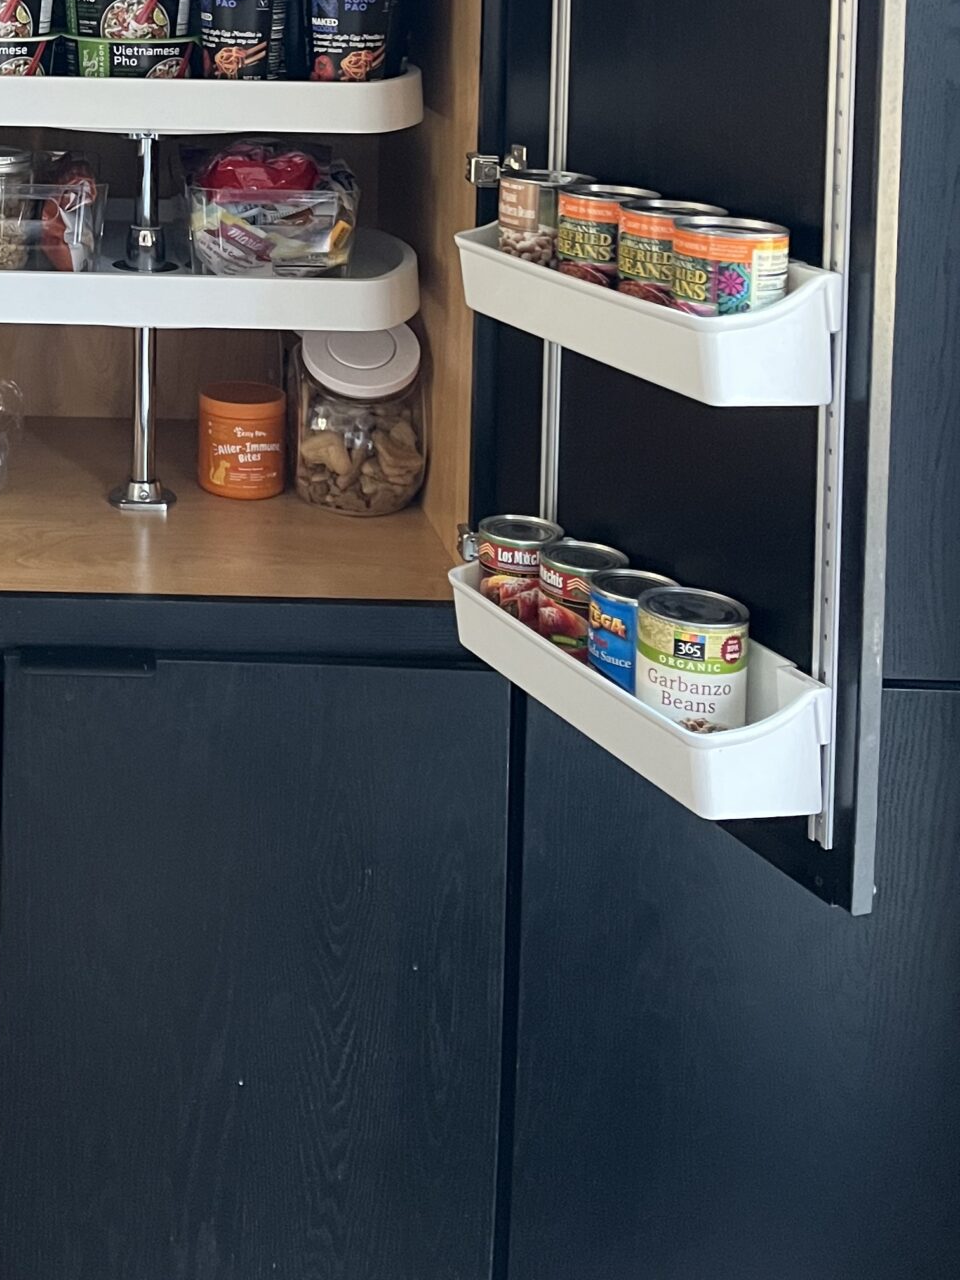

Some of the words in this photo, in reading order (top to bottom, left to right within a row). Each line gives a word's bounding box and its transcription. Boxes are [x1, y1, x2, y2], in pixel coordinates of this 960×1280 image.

[215, 0, 237, 8] PAO
[344, 3, 367, 11] PAO
[312, 17, 338, 26] NAKED
[113, 46, 180, 57] Vietnamese
[114, 56, 138, 67] Pho
[218, 442, 280, 455] Aller-Immune
[238, 453, 261, 463] Bites
[498, 547, 512, 563] Los
[677, 643, 701, 657] 365
[600, 652, 632, 669] Sauce
[659, 655, 721, 672] ORGANIC
[648, 667, 731, 696] Garbanzo
[661, 690, 716, 714] Beans
